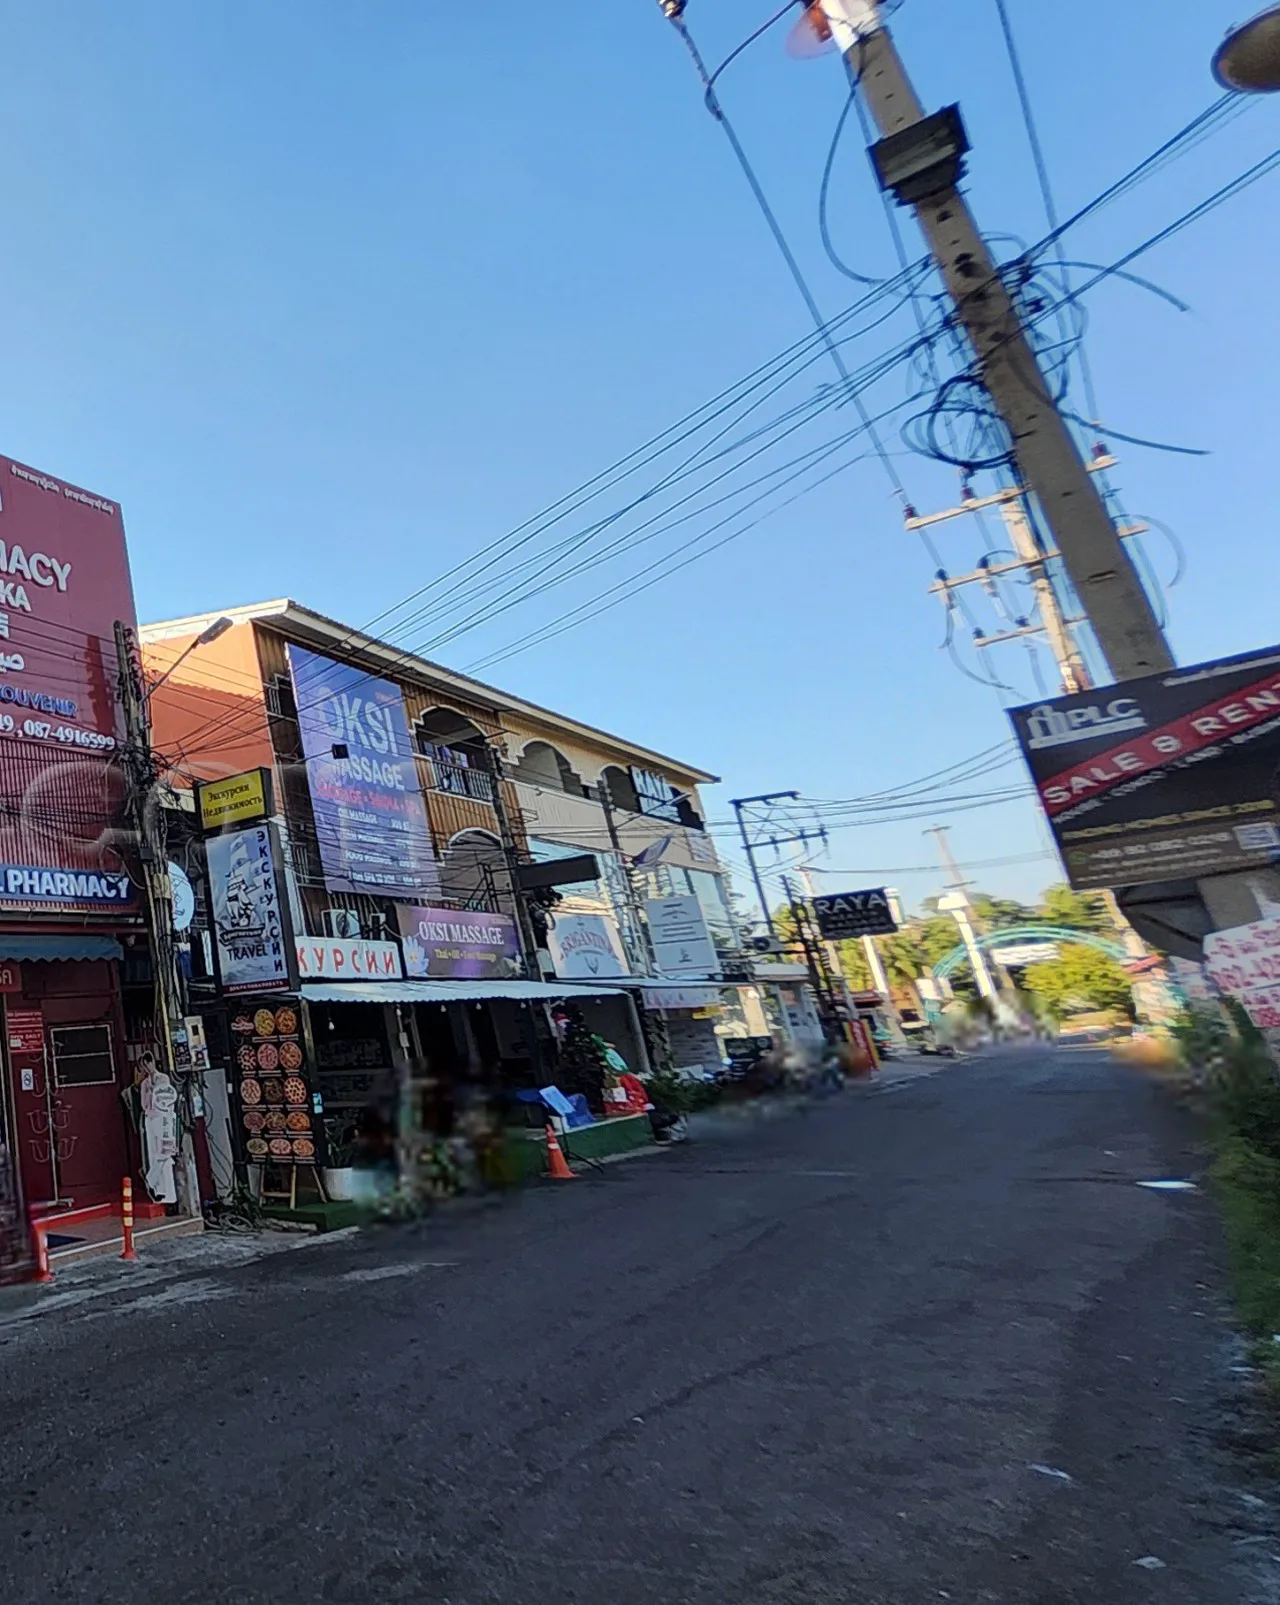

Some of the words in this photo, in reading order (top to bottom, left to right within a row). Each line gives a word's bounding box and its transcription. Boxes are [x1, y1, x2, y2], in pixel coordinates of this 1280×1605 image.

[317, 686, 399, 758] OKSI
[1043, 751, 1145, 804] SALE
[7, 868, 130, 899] PHARMACY
[815, 892, 887, 916] RAYA
[418, 921, 451, 942] OKSI
[452, 924, 505, 945] MASSAGE
[227, 943, 268, 961] TRAVEL
